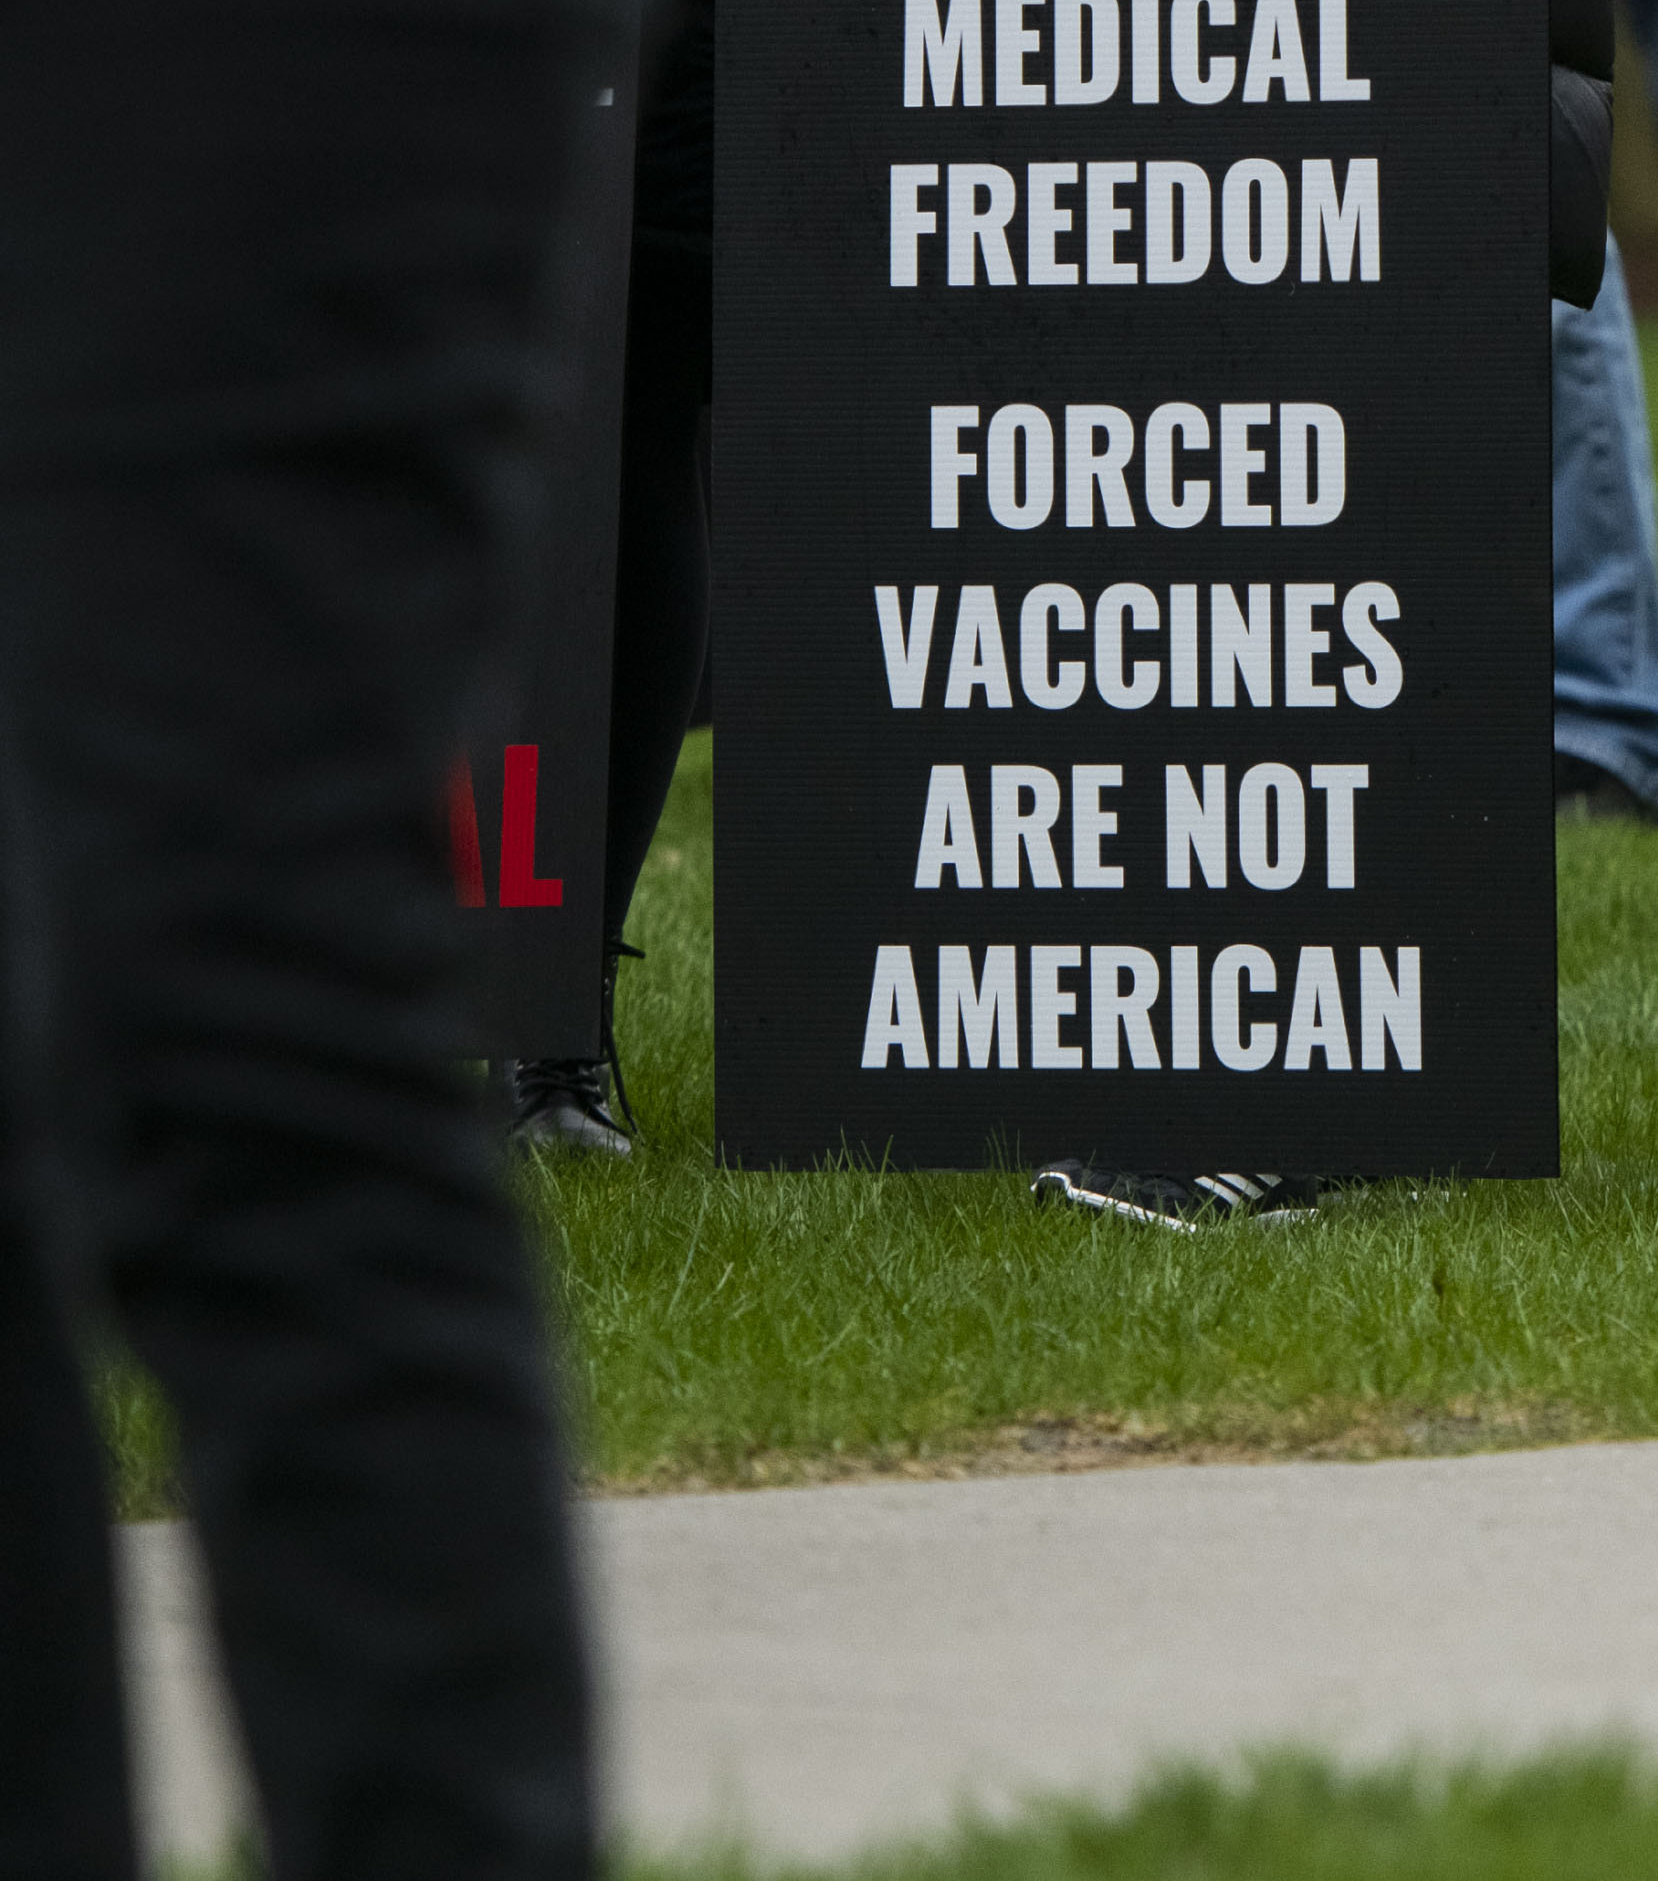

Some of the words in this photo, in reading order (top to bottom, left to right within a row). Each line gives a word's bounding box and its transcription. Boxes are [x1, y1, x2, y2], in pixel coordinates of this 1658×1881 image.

[890, 158, 1381, 286] FREEDOM
[931, 402, 1346, 530] FORCED
[874, 581, 1404, 710] VACCINES
[914, 764, 1125, 889] ARE
[1165, 763, 1370, 891] NOT
[860, 944, 1423, 1072] AMERICAN
